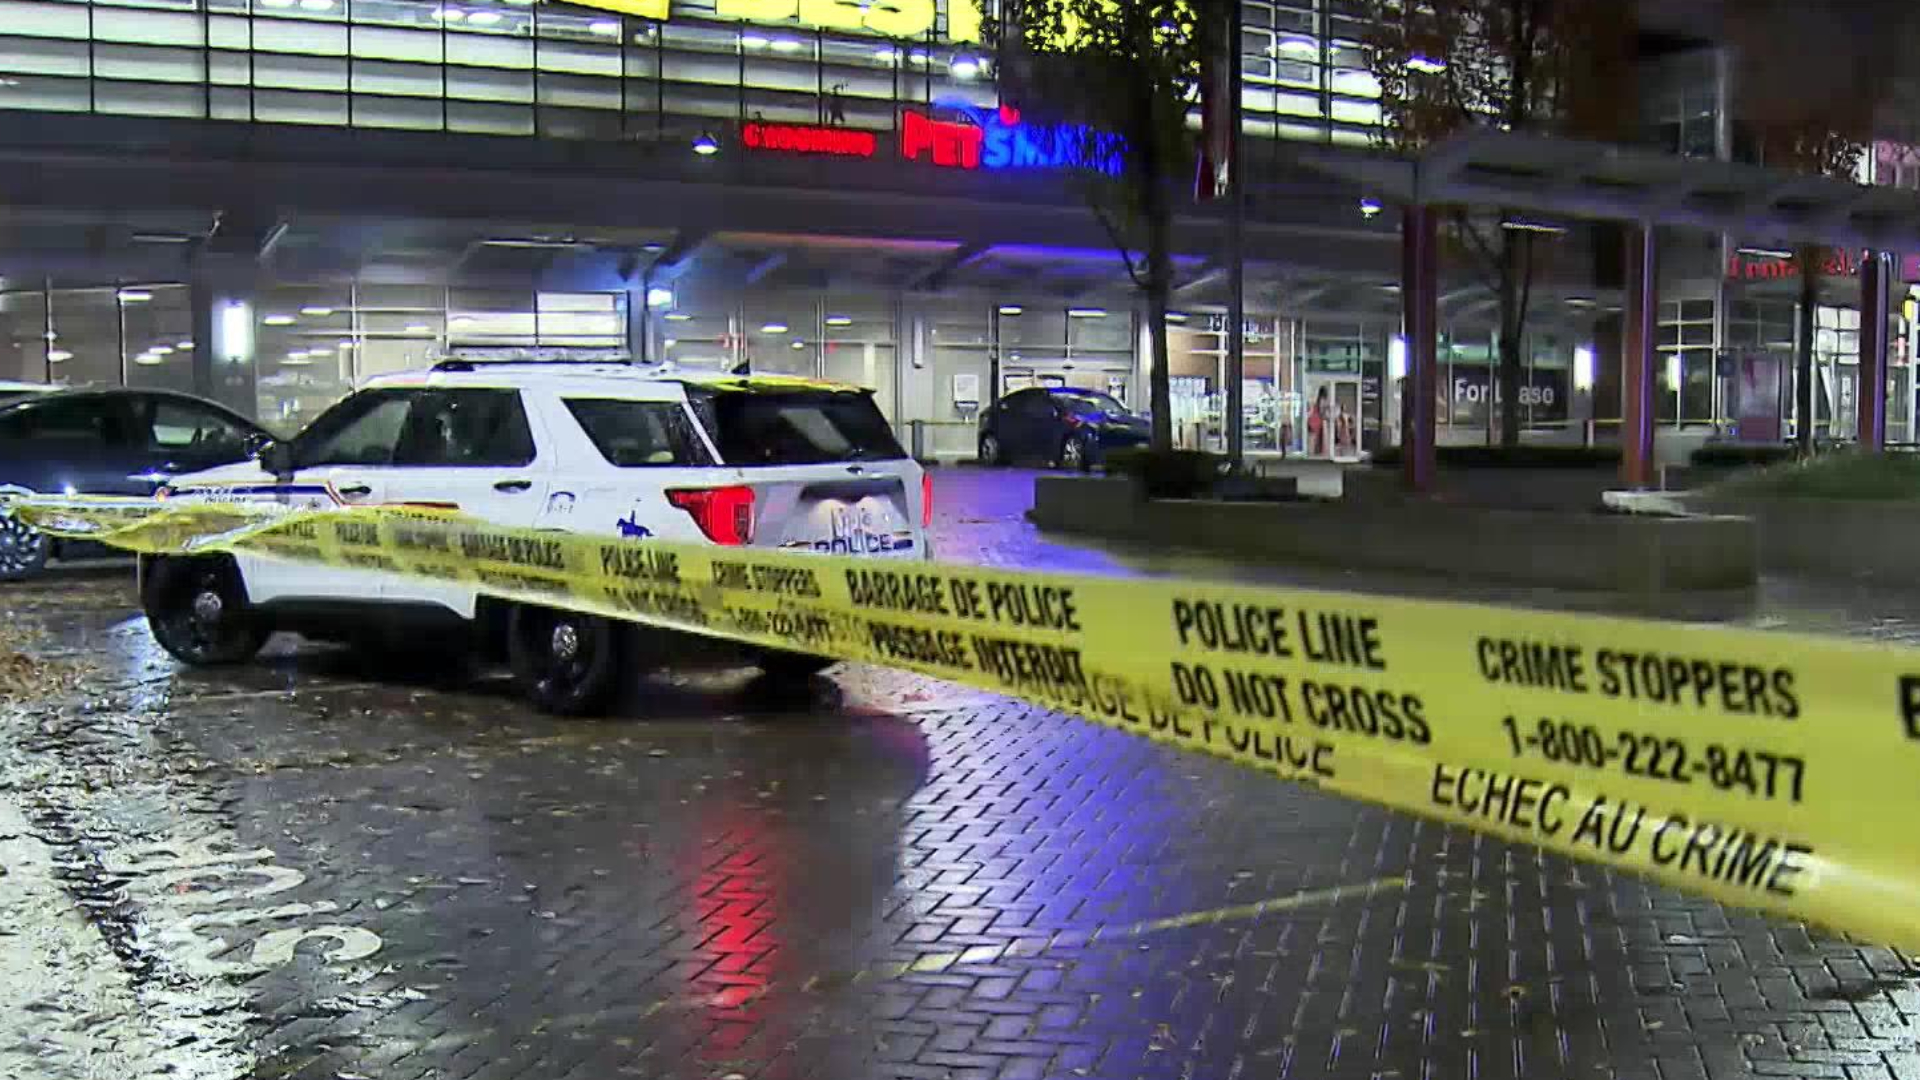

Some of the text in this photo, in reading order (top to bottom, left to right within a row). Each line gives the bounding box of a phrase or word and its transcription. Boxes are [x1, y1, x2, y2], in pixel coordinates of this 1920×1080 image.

[1454, 377, 1554, 406] For Lase
[814, 533, 895, 555] POLICE
[845, 569, 1081, 631] BARRAGE DE POLICE
[1173, 598, 1387, 671] POLICE LINE
[1171, 661, 1220, 710] DO
[1223, 668, 1293, 723] NOT
[1301, 678, 1432, 745] CROSS
[1477, 636, 1800, 720] CRIME STOPPERS
[1503, 714, 1805, 804] 1-800-222-8477
[1572, 793, 1668, 854] AU
[1650, 812, 1814, 896] CRIME
